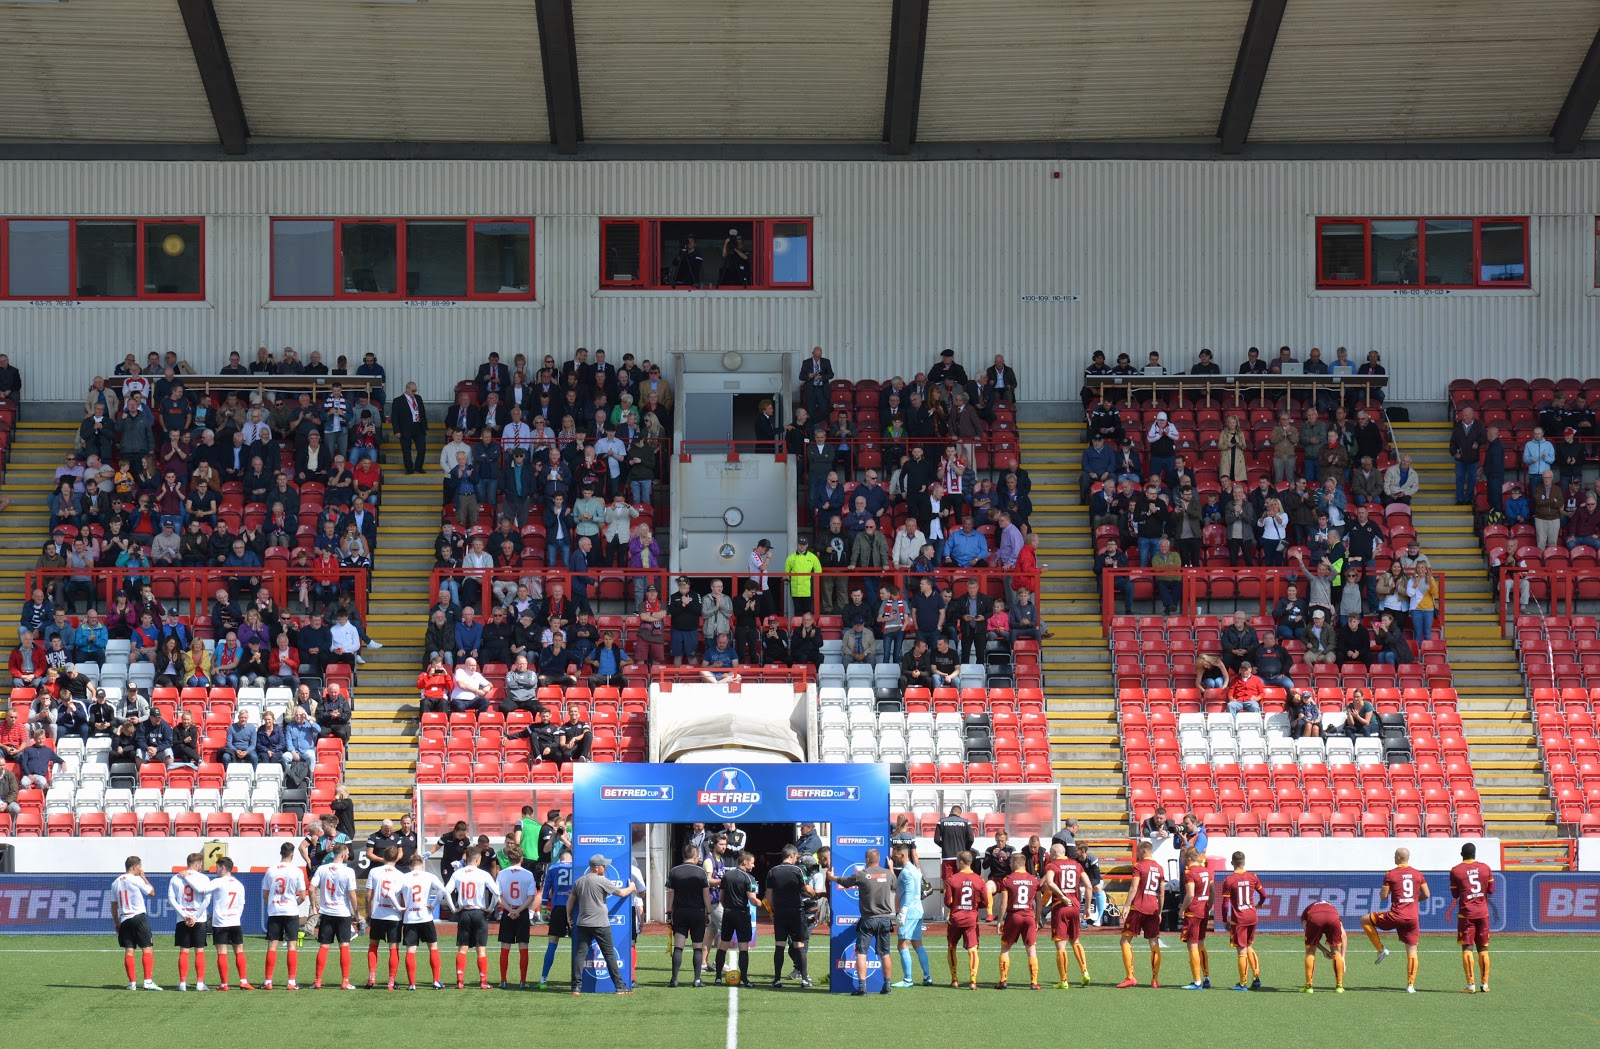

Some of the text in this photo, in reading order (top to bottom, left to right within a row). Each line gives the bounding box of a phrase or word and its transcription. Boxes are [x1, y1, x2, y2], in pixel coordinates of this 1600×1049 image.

[604, 788, 647, 797] BETFRED
[700, 792, 760, 803] BETFRED
[791, 789, 834, 797] BETFRED
[722, 806, 738, 814] CUP
[358, 851, 371, 869] 5
[275, 878, 286, 895] 3
[326, 879, 335, 898] 4
[1061, 870, 1077, 889] 19
[1145, 871, 1160, 891] 15
[1202, 876, 1209, 896] 7
[1403, 879, 1413, 898] 9
[1469, 874, 1481, 894] 5
[119, 890, 130, 908] 11
[183, 884, 194, 903] 9
[381, 881, 391, 899] 5
[412, 885, 422, 902] 2
[461, 882, 476, 899] 10
[510, 882, 520, 899] 6
[961, 886, 973, 905] 2
[1017, 885, 1029, 904] 8
[1238, 886, 1250, 905] 11
[0, 889, 175, 919] TFRE UP
[228, 892, 237, 910] 7
[1227, 888, 1446, 917] ETFRED UP
[1547, 888, 1600, 917] BE
[583, 960, 624, 968] BETFD
